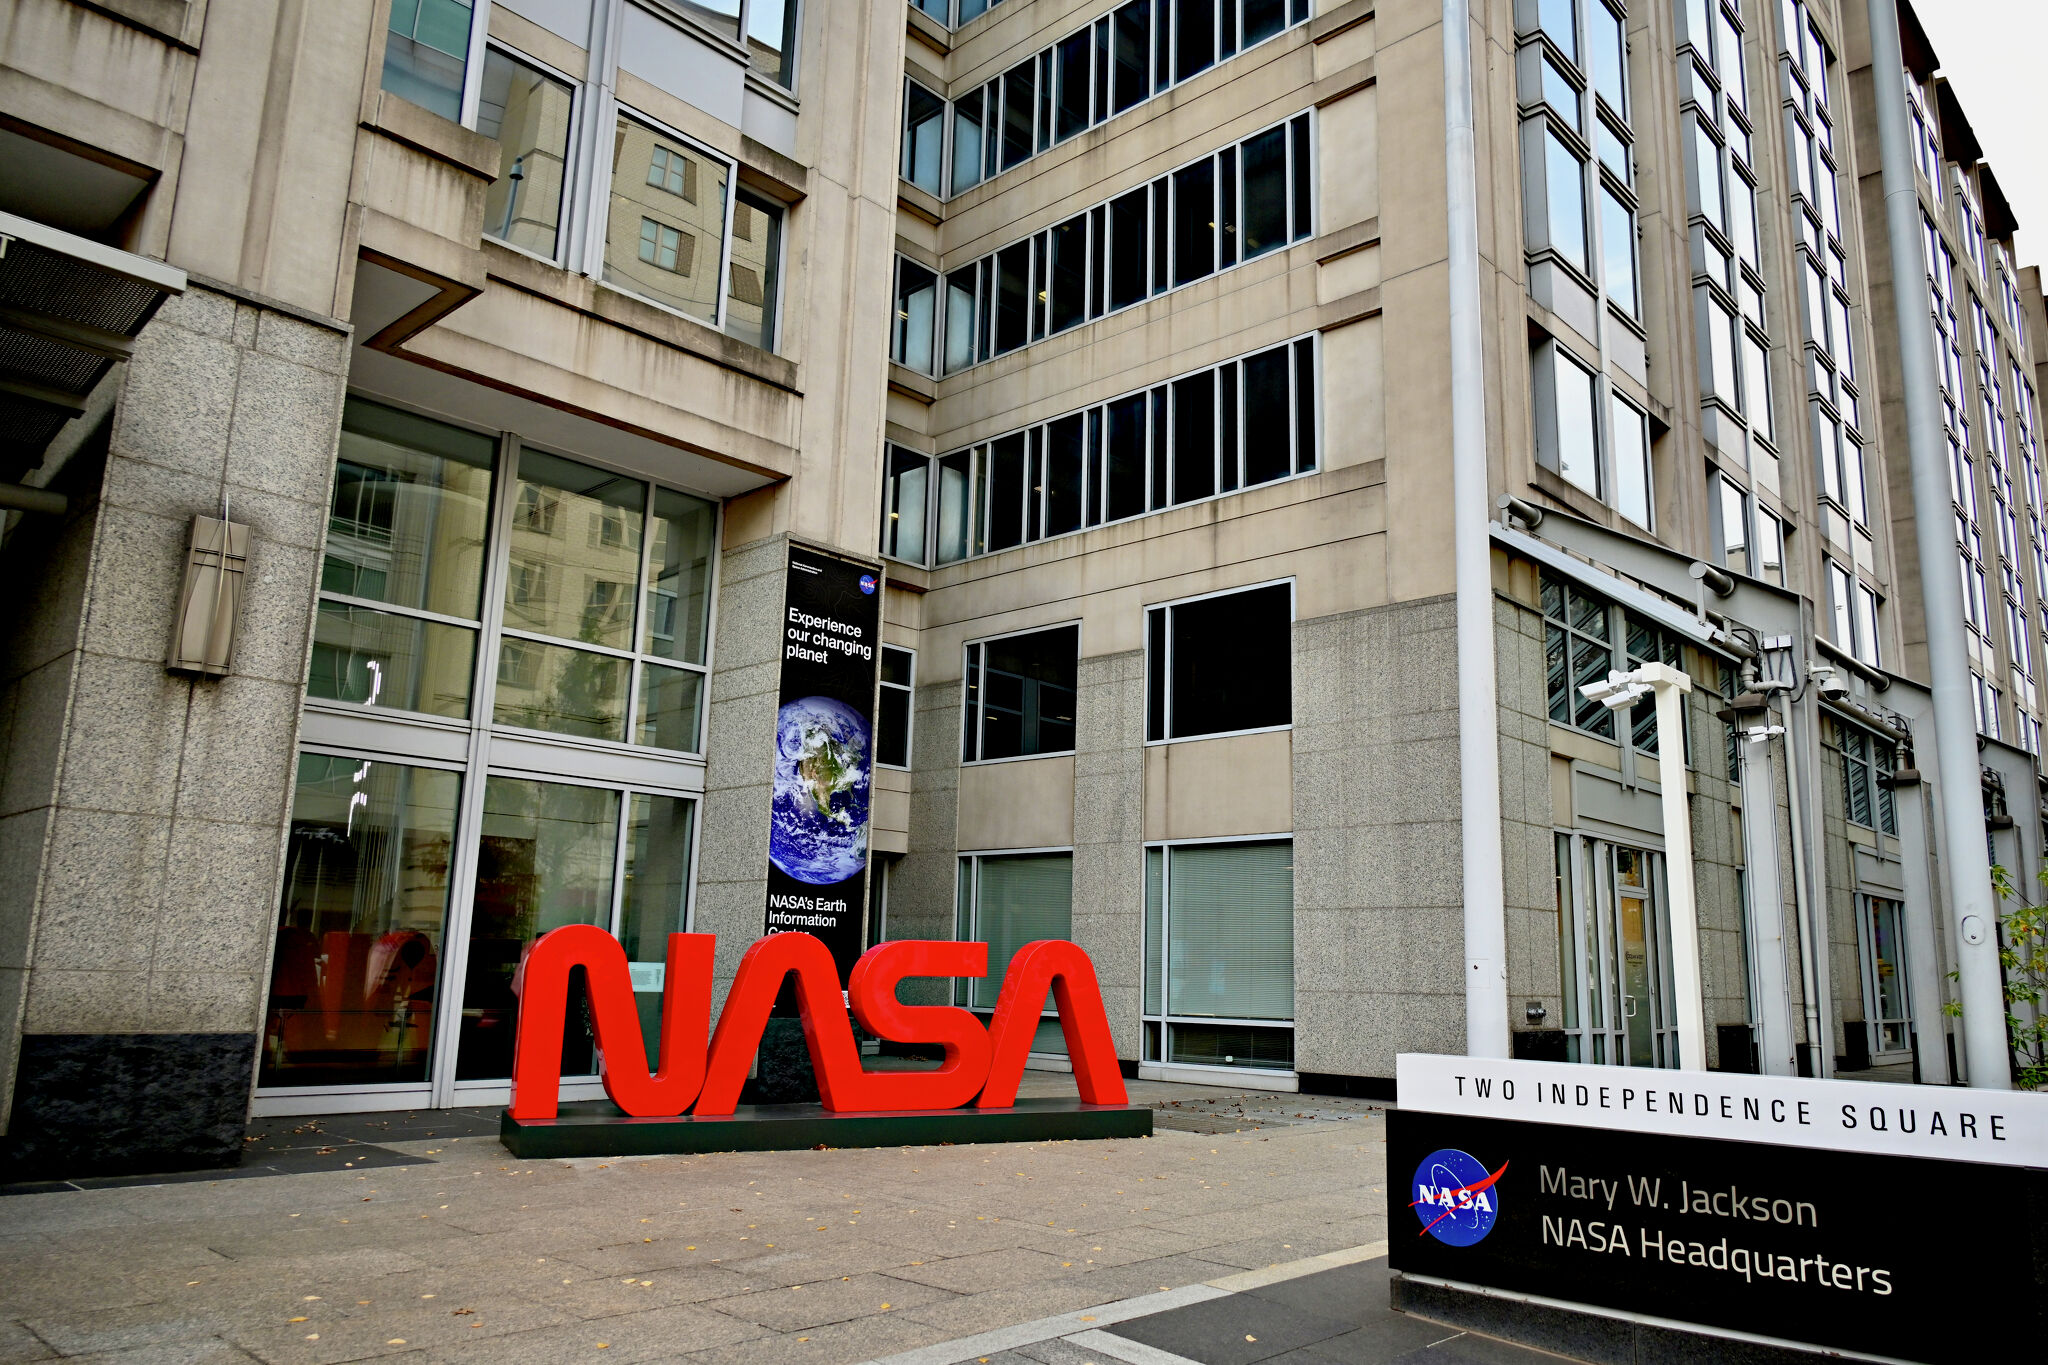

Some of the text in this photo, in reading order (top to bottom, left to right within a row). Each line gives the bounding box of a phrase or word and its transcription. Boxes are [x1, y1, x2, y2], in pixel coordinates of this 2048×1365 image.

[788, 606, 862, 638] Experience
[786, 644, 829, 665] planet
[787, 627, 872, 661] our changing
[768, 910, 837, 927] Information
[815, 897, 847, 913] Earth
[510, 924, 1129, 1119] NASA
[1454, 1076, 2006, 1141] TWO INDEPENDENCE SQUARE
[1418, 1184, 1493, 1213] NASA
[1539, 1164, 1817, 1228] Mary W. Jackson
[1542, 1215, 1893, 1296] NASA Headquarters
